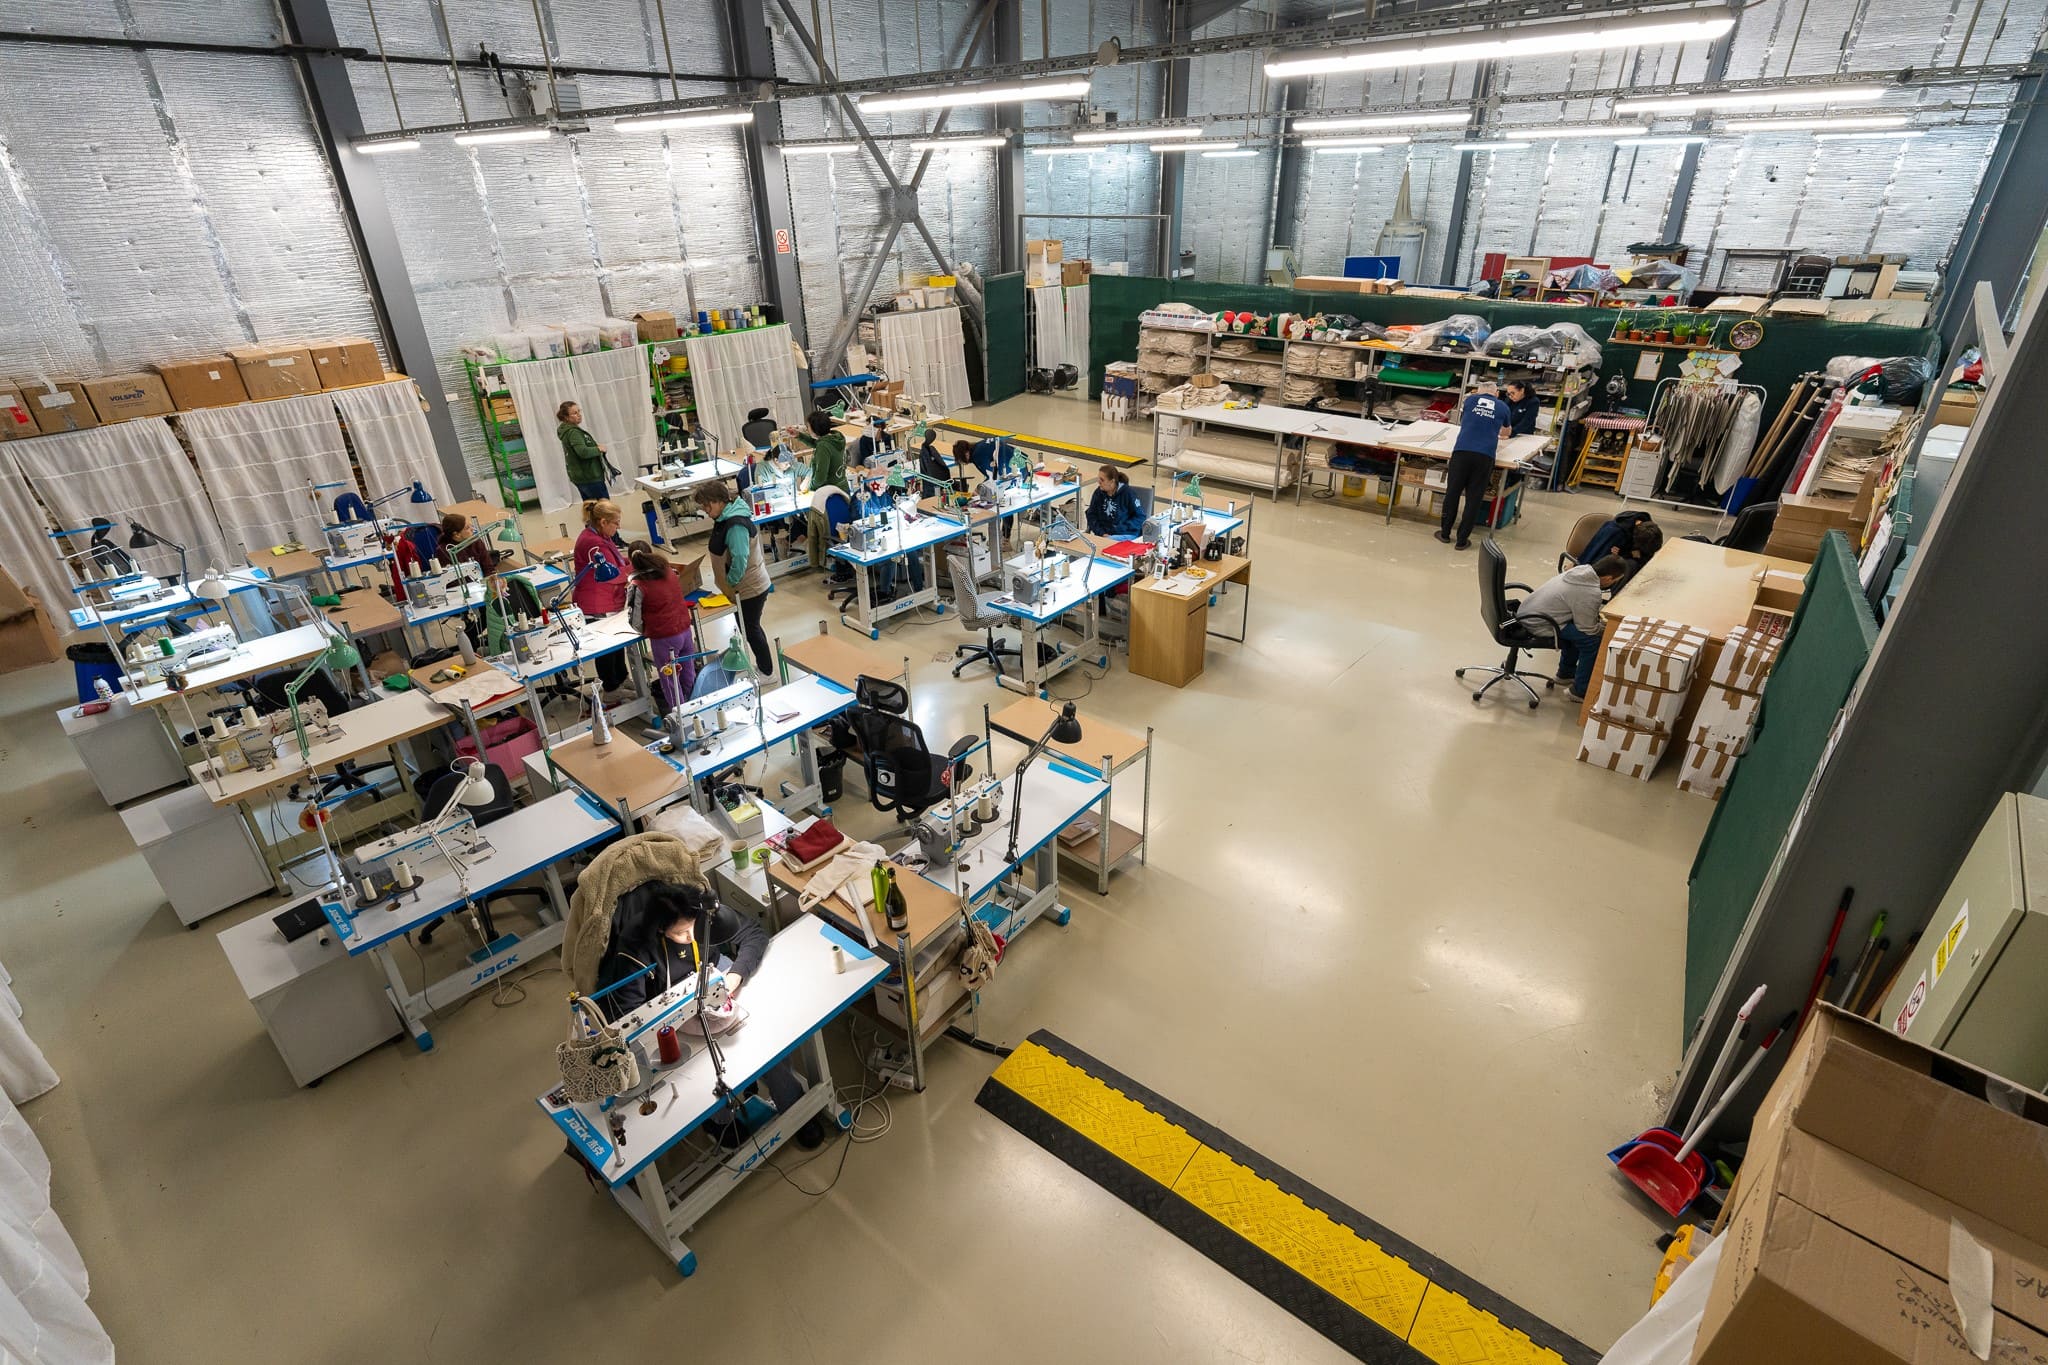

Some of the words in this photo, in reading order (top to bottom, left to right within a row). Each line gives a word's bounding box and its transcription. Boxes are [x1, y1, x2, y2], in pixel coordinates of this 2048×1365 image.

[893, 599, 914, 611] JACK
[471, 953, 519, 985] JACK
[563, 1117, 591, 1142] JACK
[732, 1130, 782, 1180] JACK
